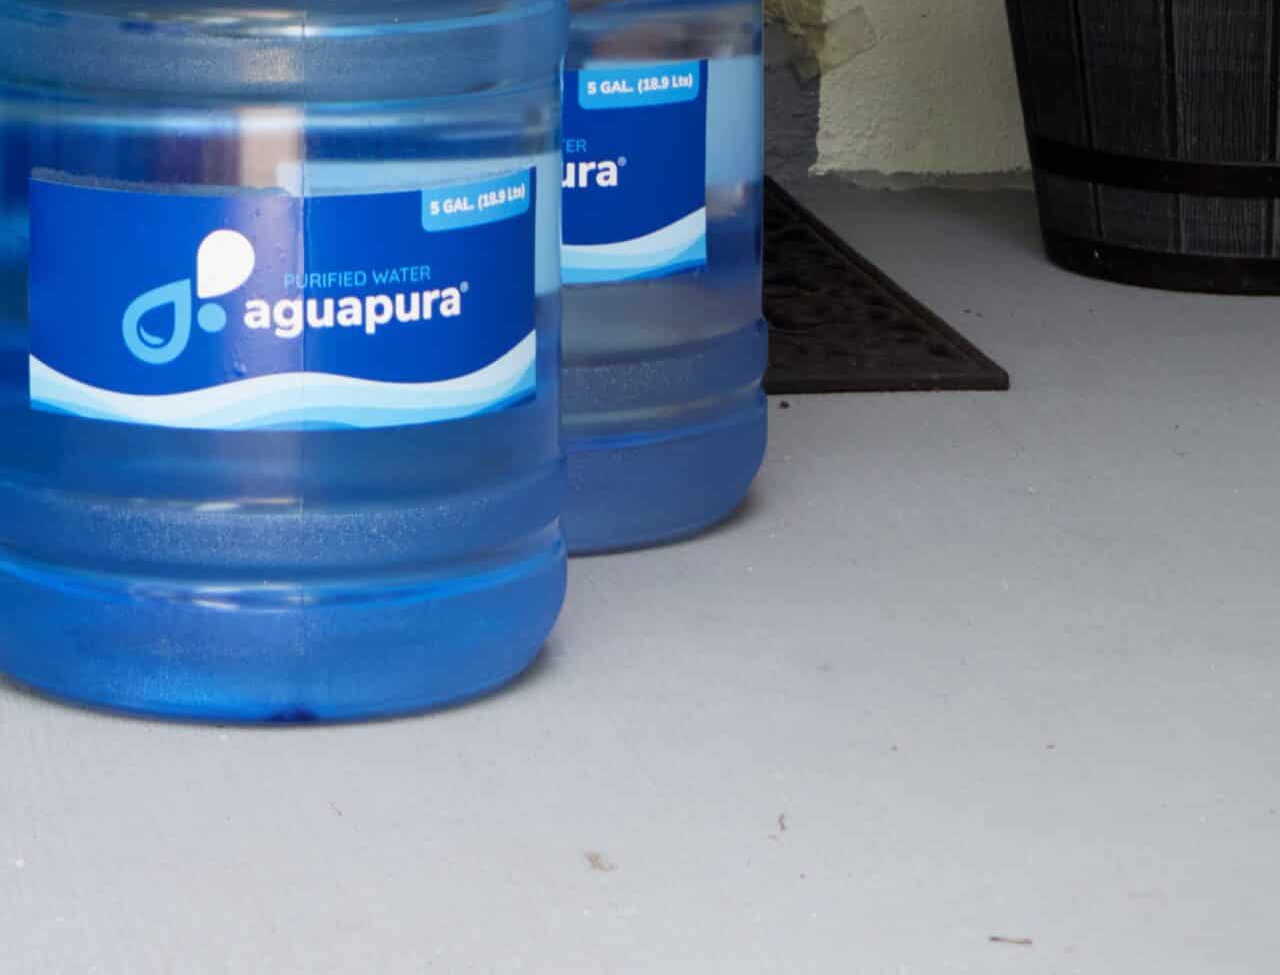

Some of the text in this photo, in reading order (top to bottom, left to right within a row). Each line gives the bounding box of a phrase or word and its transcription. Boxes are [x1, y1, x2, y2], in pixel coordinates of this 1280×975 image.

[587, 81, 597, 95] 5
[600, 78, 634, 95] GAL.
[430, 200, 439, 216] 5
[443, 196, 474, 214] GAL.
[283, 265, 431, 289] PURIFIED WATER
